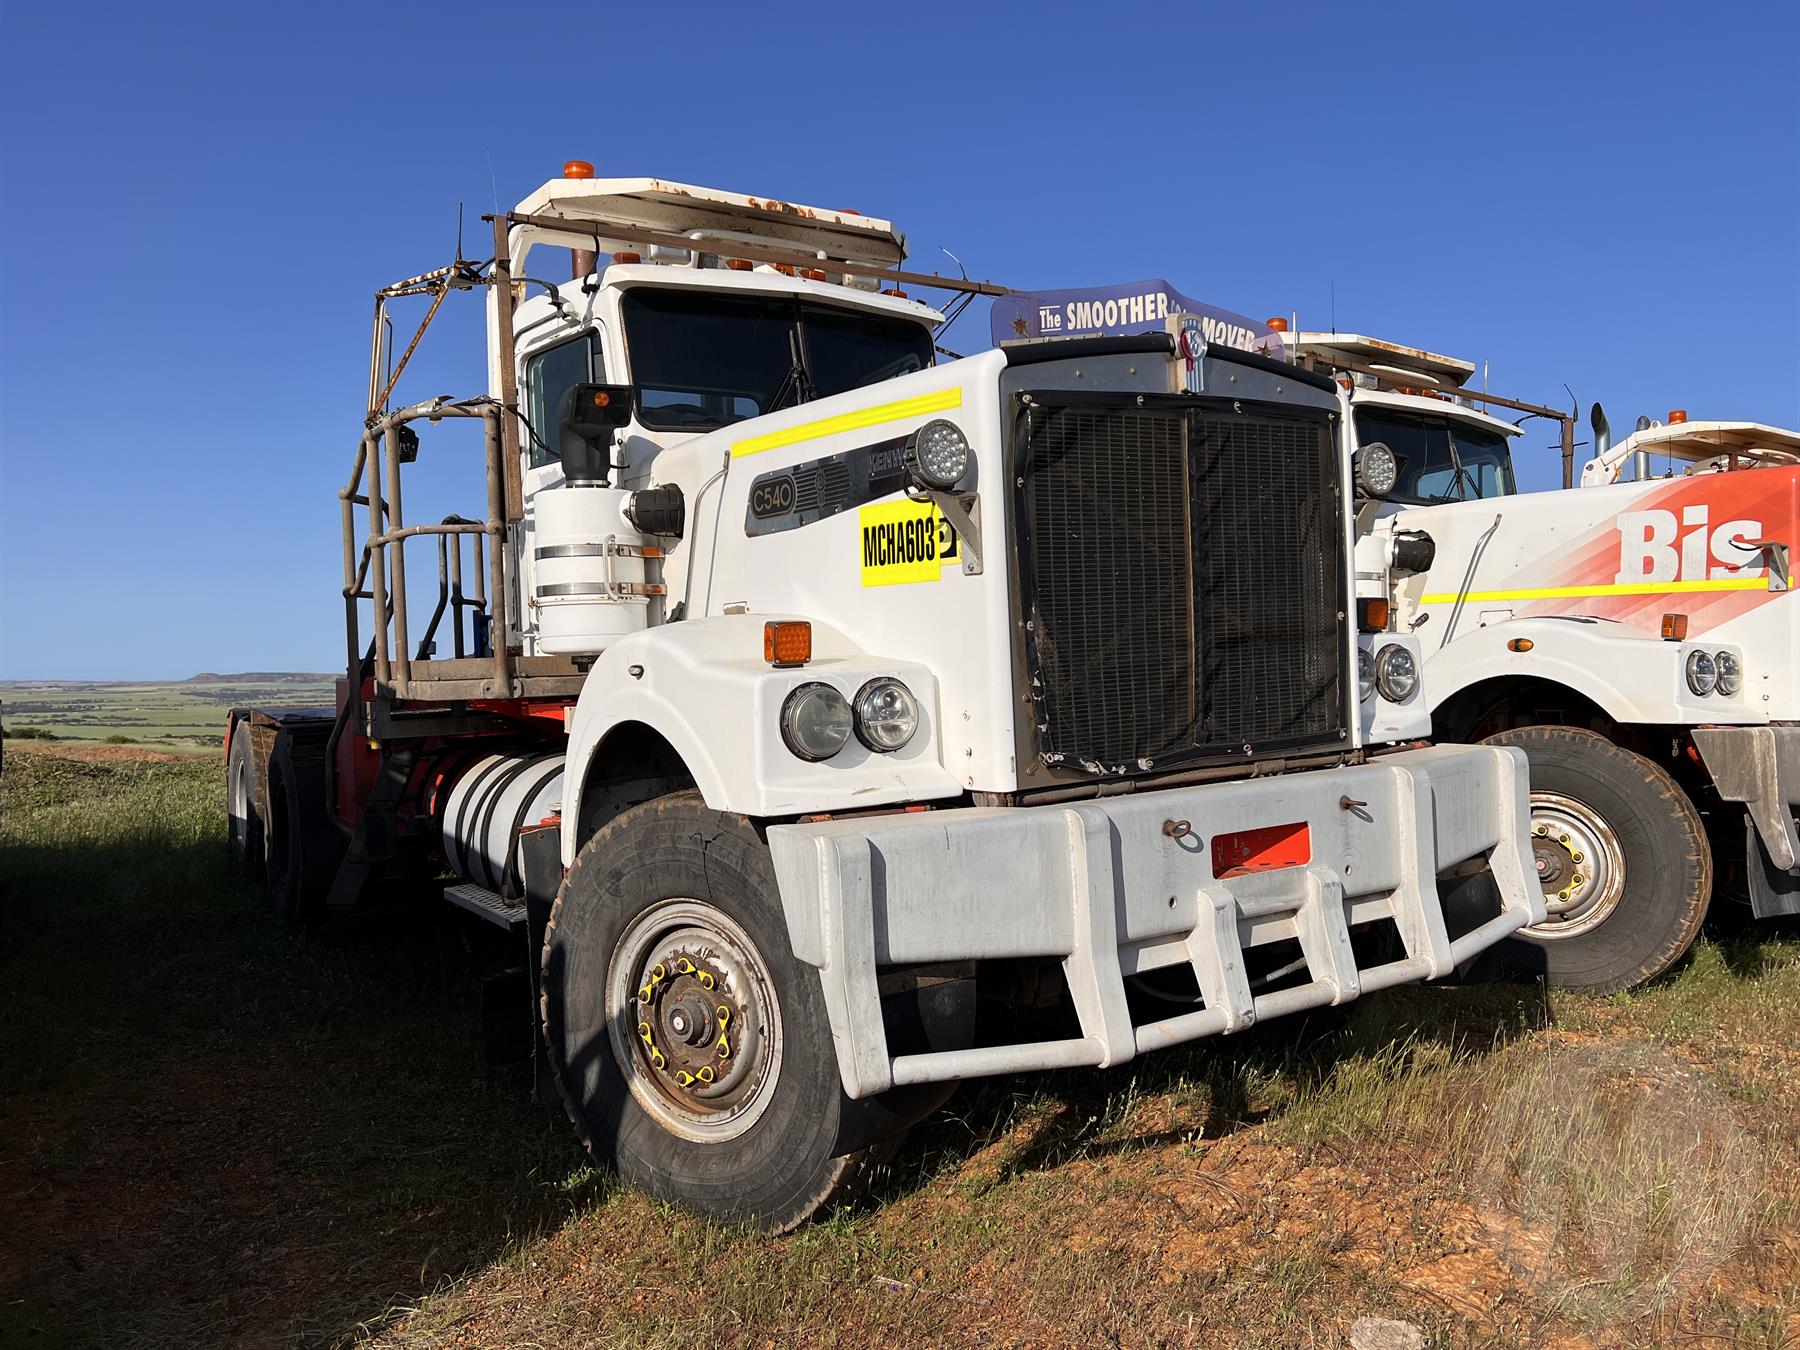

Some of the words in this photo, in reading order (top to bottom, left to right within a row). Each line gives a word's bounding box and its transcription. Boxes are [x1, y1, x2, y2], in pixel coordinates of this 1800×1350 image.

[1039, 308, 1062, 329] The
[1066, 292, 1169, 330] SMOOTHER
[1202, 316, 1256, 353] MOVER
[863, 516, 936, 568] MCHA603
[1615, 504, 1764, 584] Bis
